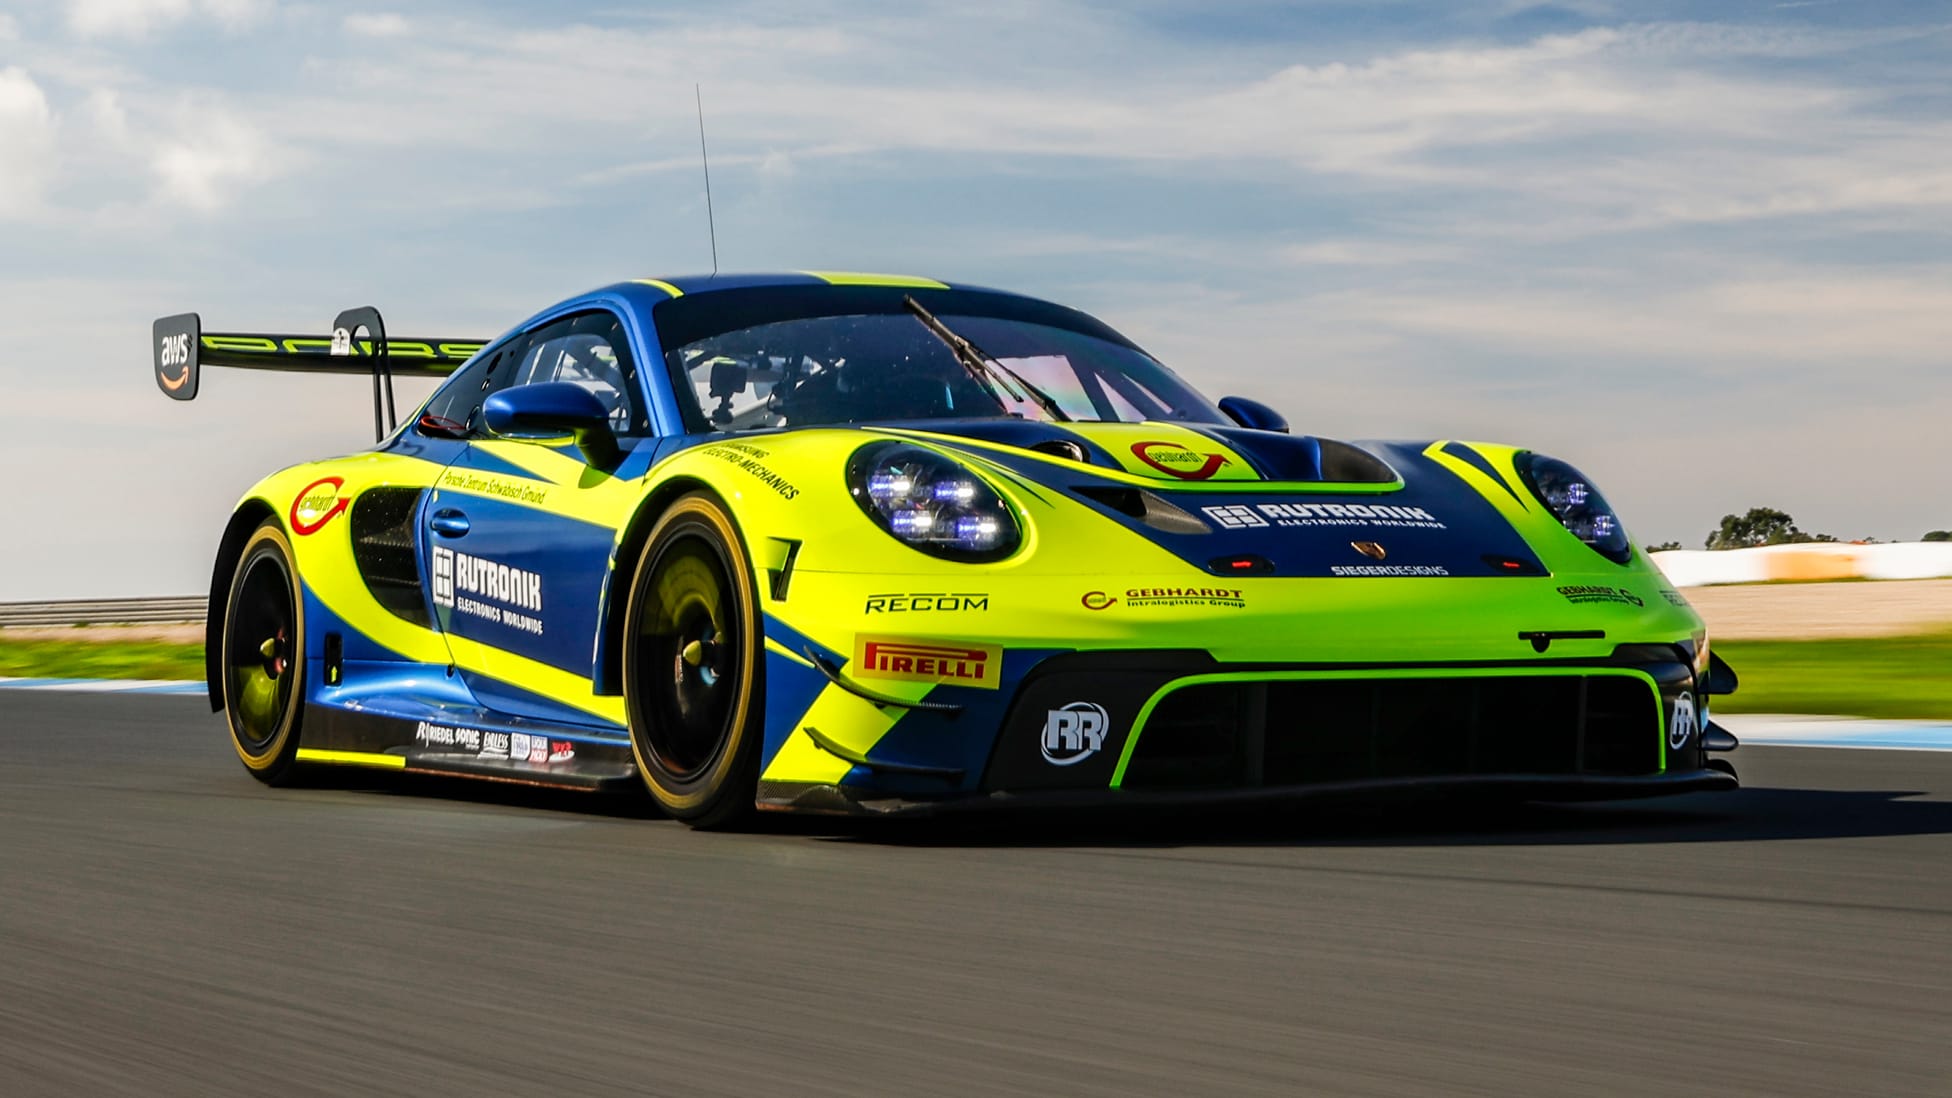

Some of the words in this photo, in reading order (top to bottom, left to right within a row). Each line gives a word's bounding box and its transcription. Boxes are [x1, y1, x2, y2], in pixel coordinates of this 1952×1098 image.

[162, 333, 188, 367] aws
[1257, 503, 1436, 521] RUTRONIK
[1277, 518, 1369, 527] ELECTRONICS
[1372, 519, 1447, 529] WORLDWIDE
[1330, 566, 1450, 576] SIEGERDESIGNS
[456, 552, 542, 612] RUTRONIK
[1125, 588, 1243, 598] GEBHARDT
[865, 593, 989, 614] RECOM
[1127, 599, 1206, 607] Intralogistics
[1209, 600, 1246, 609] Group
[457, 596, 501, 622] ELECTRONICS
[503, 609, 543, 635] WORLDWIDE
[864, 642, 989, 679] PIRELLI
